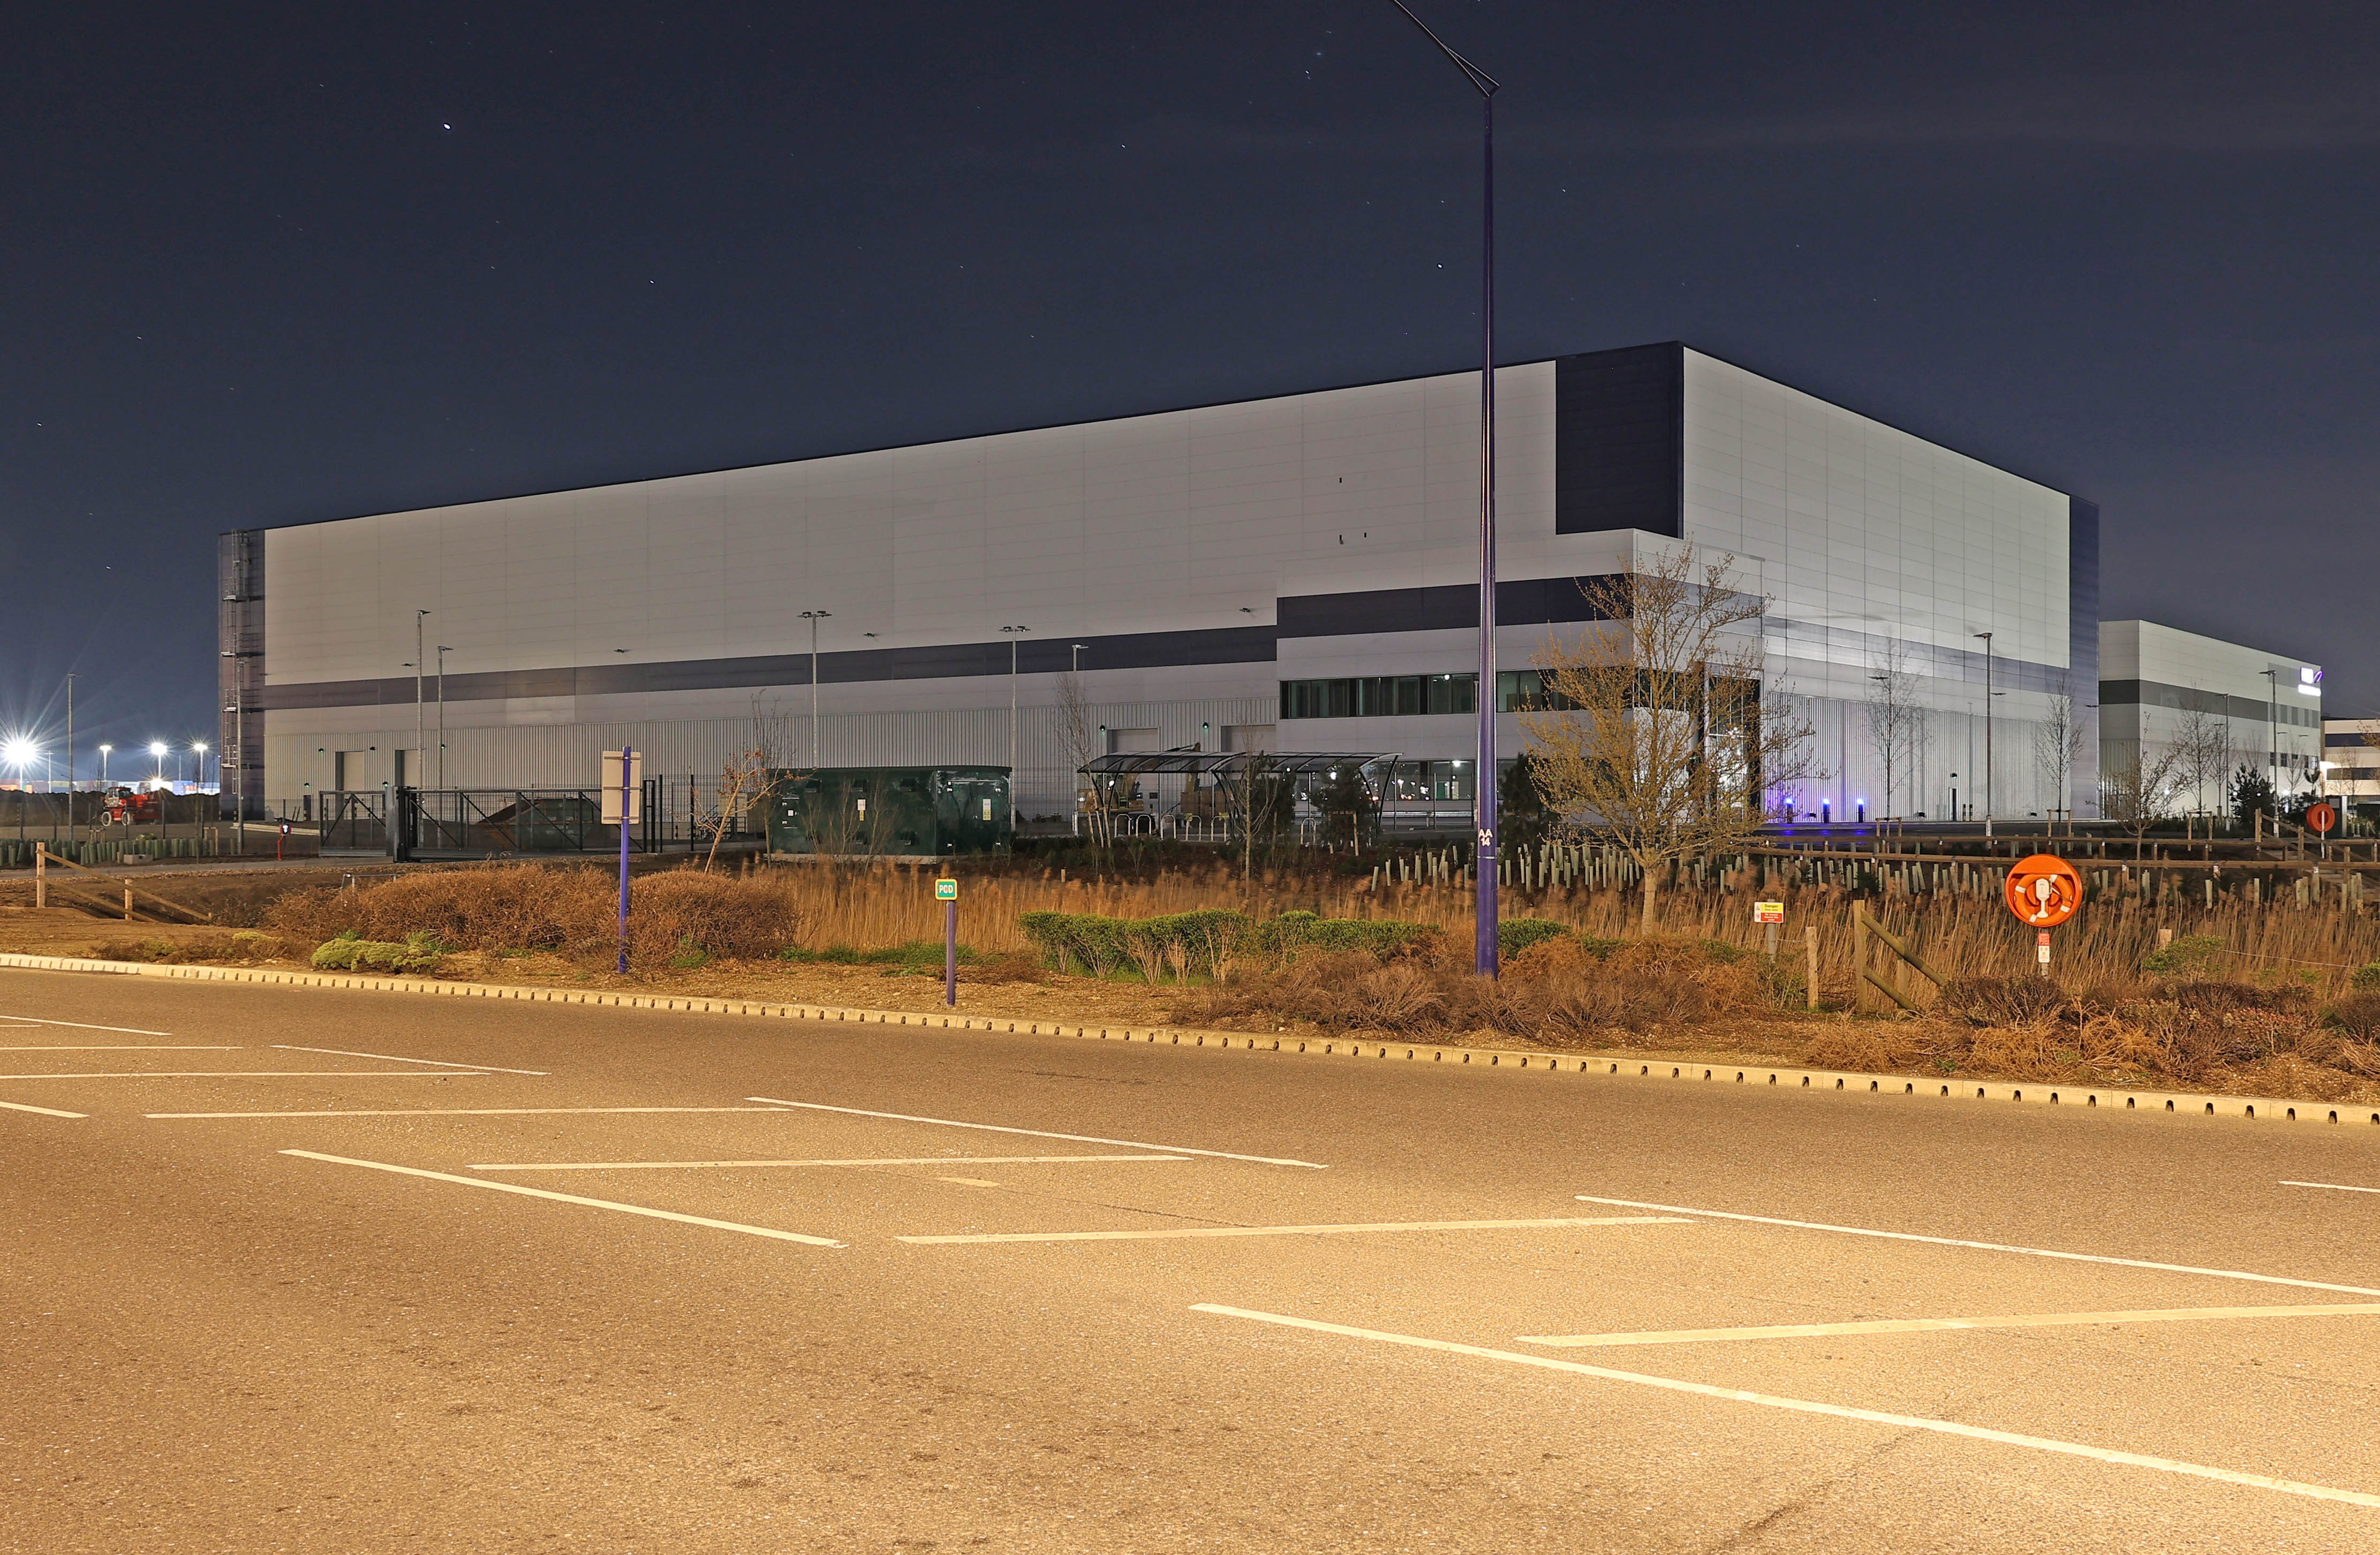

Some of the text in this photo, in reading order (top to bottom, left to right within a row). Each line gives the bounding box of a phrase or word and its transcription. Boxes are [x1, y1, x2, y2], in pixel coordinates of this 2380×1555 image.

[1479, 829, 1493, 838] AA
[1480, 838, 1491, 846] 14
[939, 885, 953, 893] PCD
